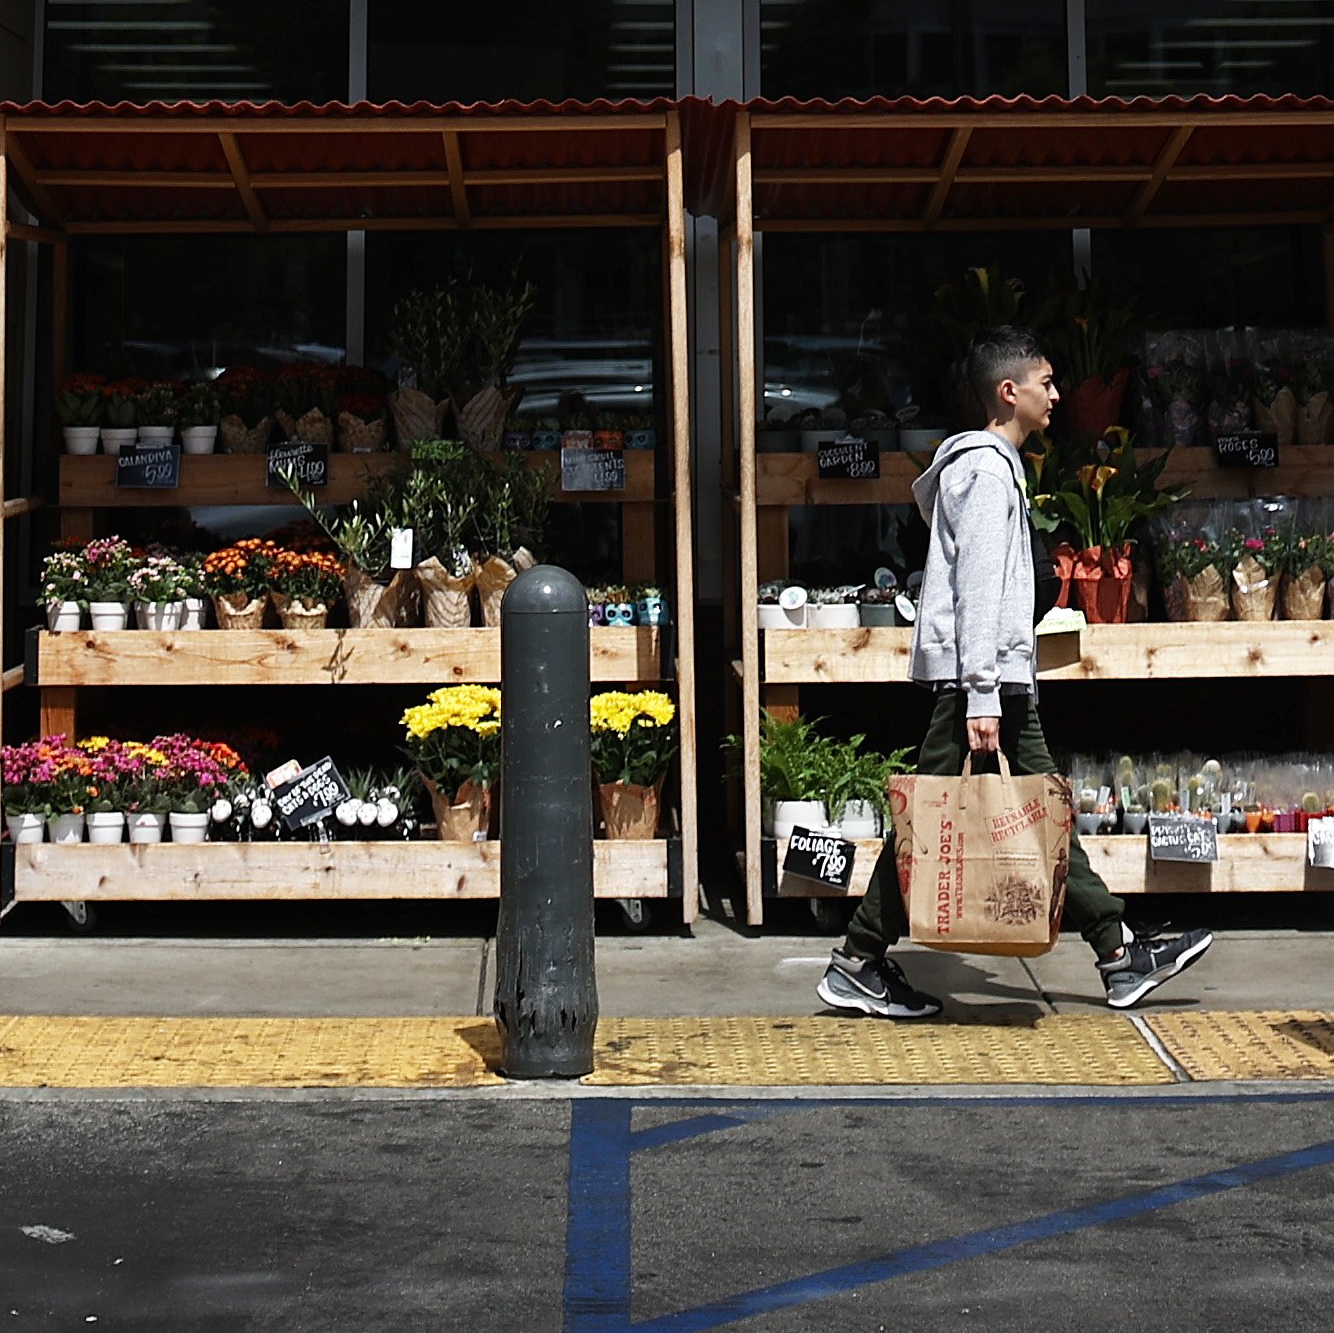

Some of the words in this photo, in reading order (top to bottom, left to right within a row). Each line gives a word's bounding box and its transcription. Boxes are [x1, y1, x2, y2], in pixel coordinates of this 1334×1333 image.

[1218, 438, 1258, 454] ROSES
[118, 450, 173, 468] CALANDIVA
[819, 451, 863, 468] GARDEN
[991, 797, 1042, 830] REUSABLE
[990, 806, 1050, 844] RECYCLABLE
[790, 835, 845, 856] FOLIAGE
[937, 870, 951, 935] TRADER
